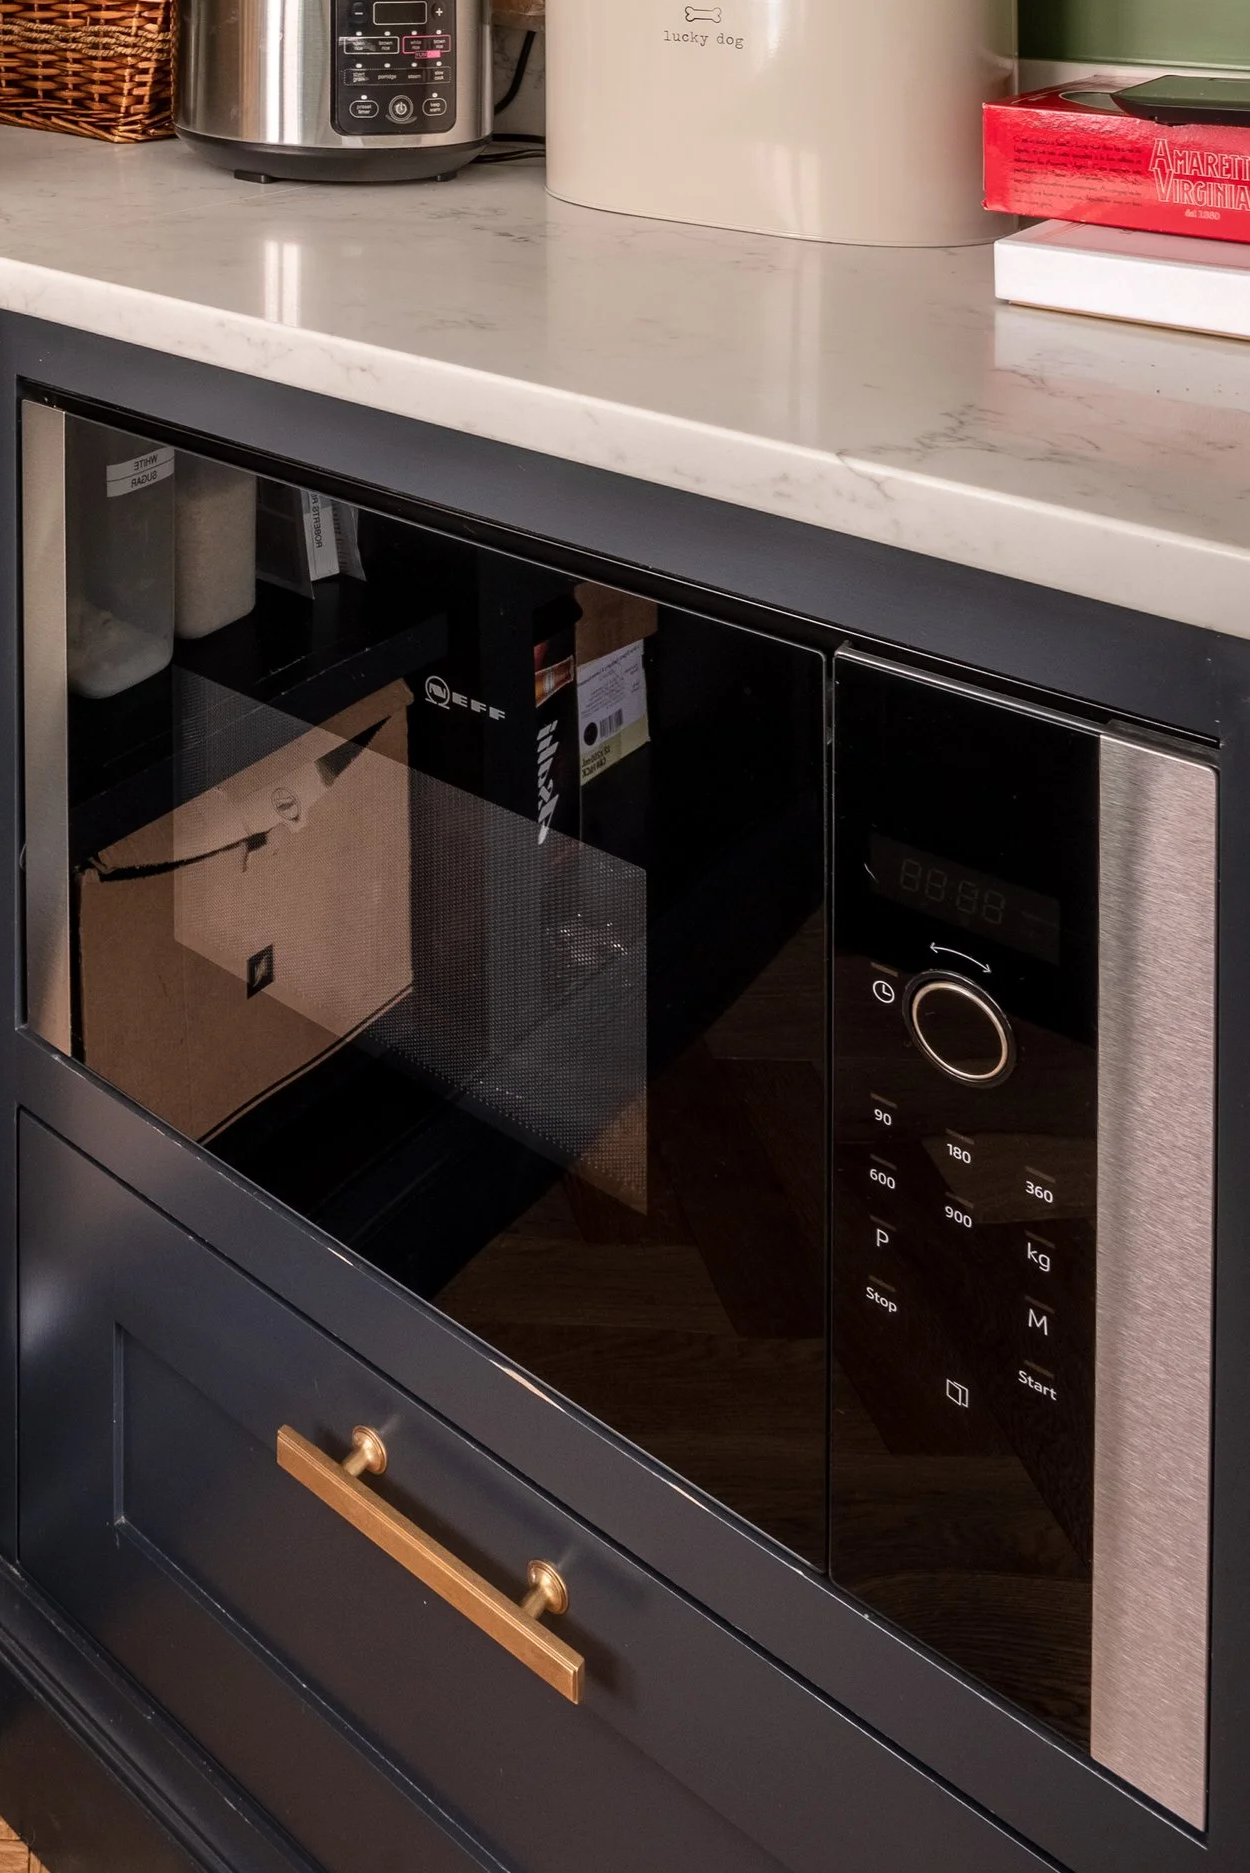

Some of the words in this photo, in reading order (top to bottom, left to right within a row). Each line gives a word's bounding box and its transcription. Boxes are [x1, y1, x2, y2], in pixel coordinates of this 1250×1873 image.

[663, 30, 709, 47] lucky
[716, 33, 745, 50] dog
[1154, 168, 1250, 212] VIRGINIA
[874, 1108, 892, 1126] 90
[946, 1143, 972, 1164] 180
[869, 1168, 896, 1190] 600
[1025, 1180, 1054, 1203] 360
[945, 1205, 973, 1228] 900
[876, 1228, 890, 1247] P
[1027, 1242, 1051, 1272] kg
[865, 1286, 898, 1313] Stop
[1028, 1308, 1049, 1336] M
[1017, 1370, 1058, 1401] Start
